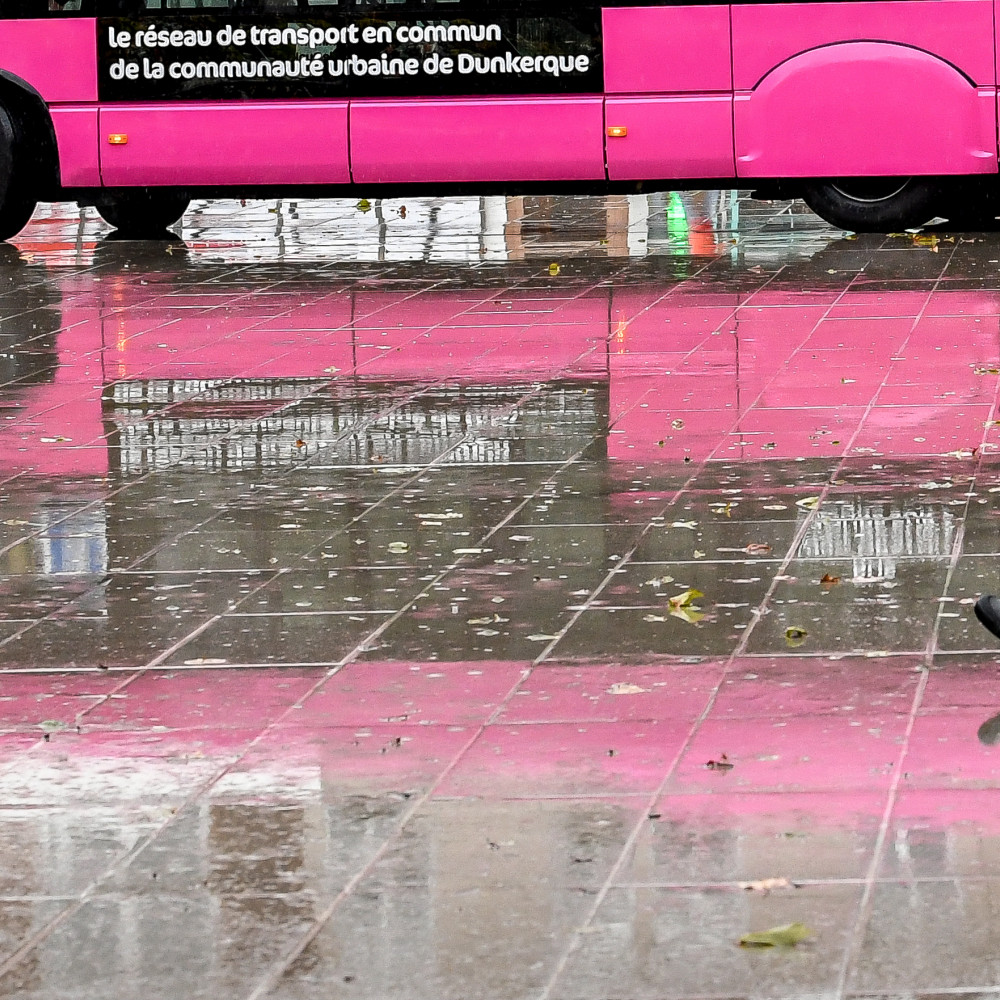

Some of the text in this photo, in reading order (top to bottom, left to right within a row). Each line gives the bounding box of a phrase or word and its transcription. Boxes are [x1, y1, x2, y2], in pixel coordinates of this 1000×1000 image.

[109, 24, 501, 48] le réseau de transport en commun
[110, 52, 589, 79] de la communauté urbaine de Dunkerque
